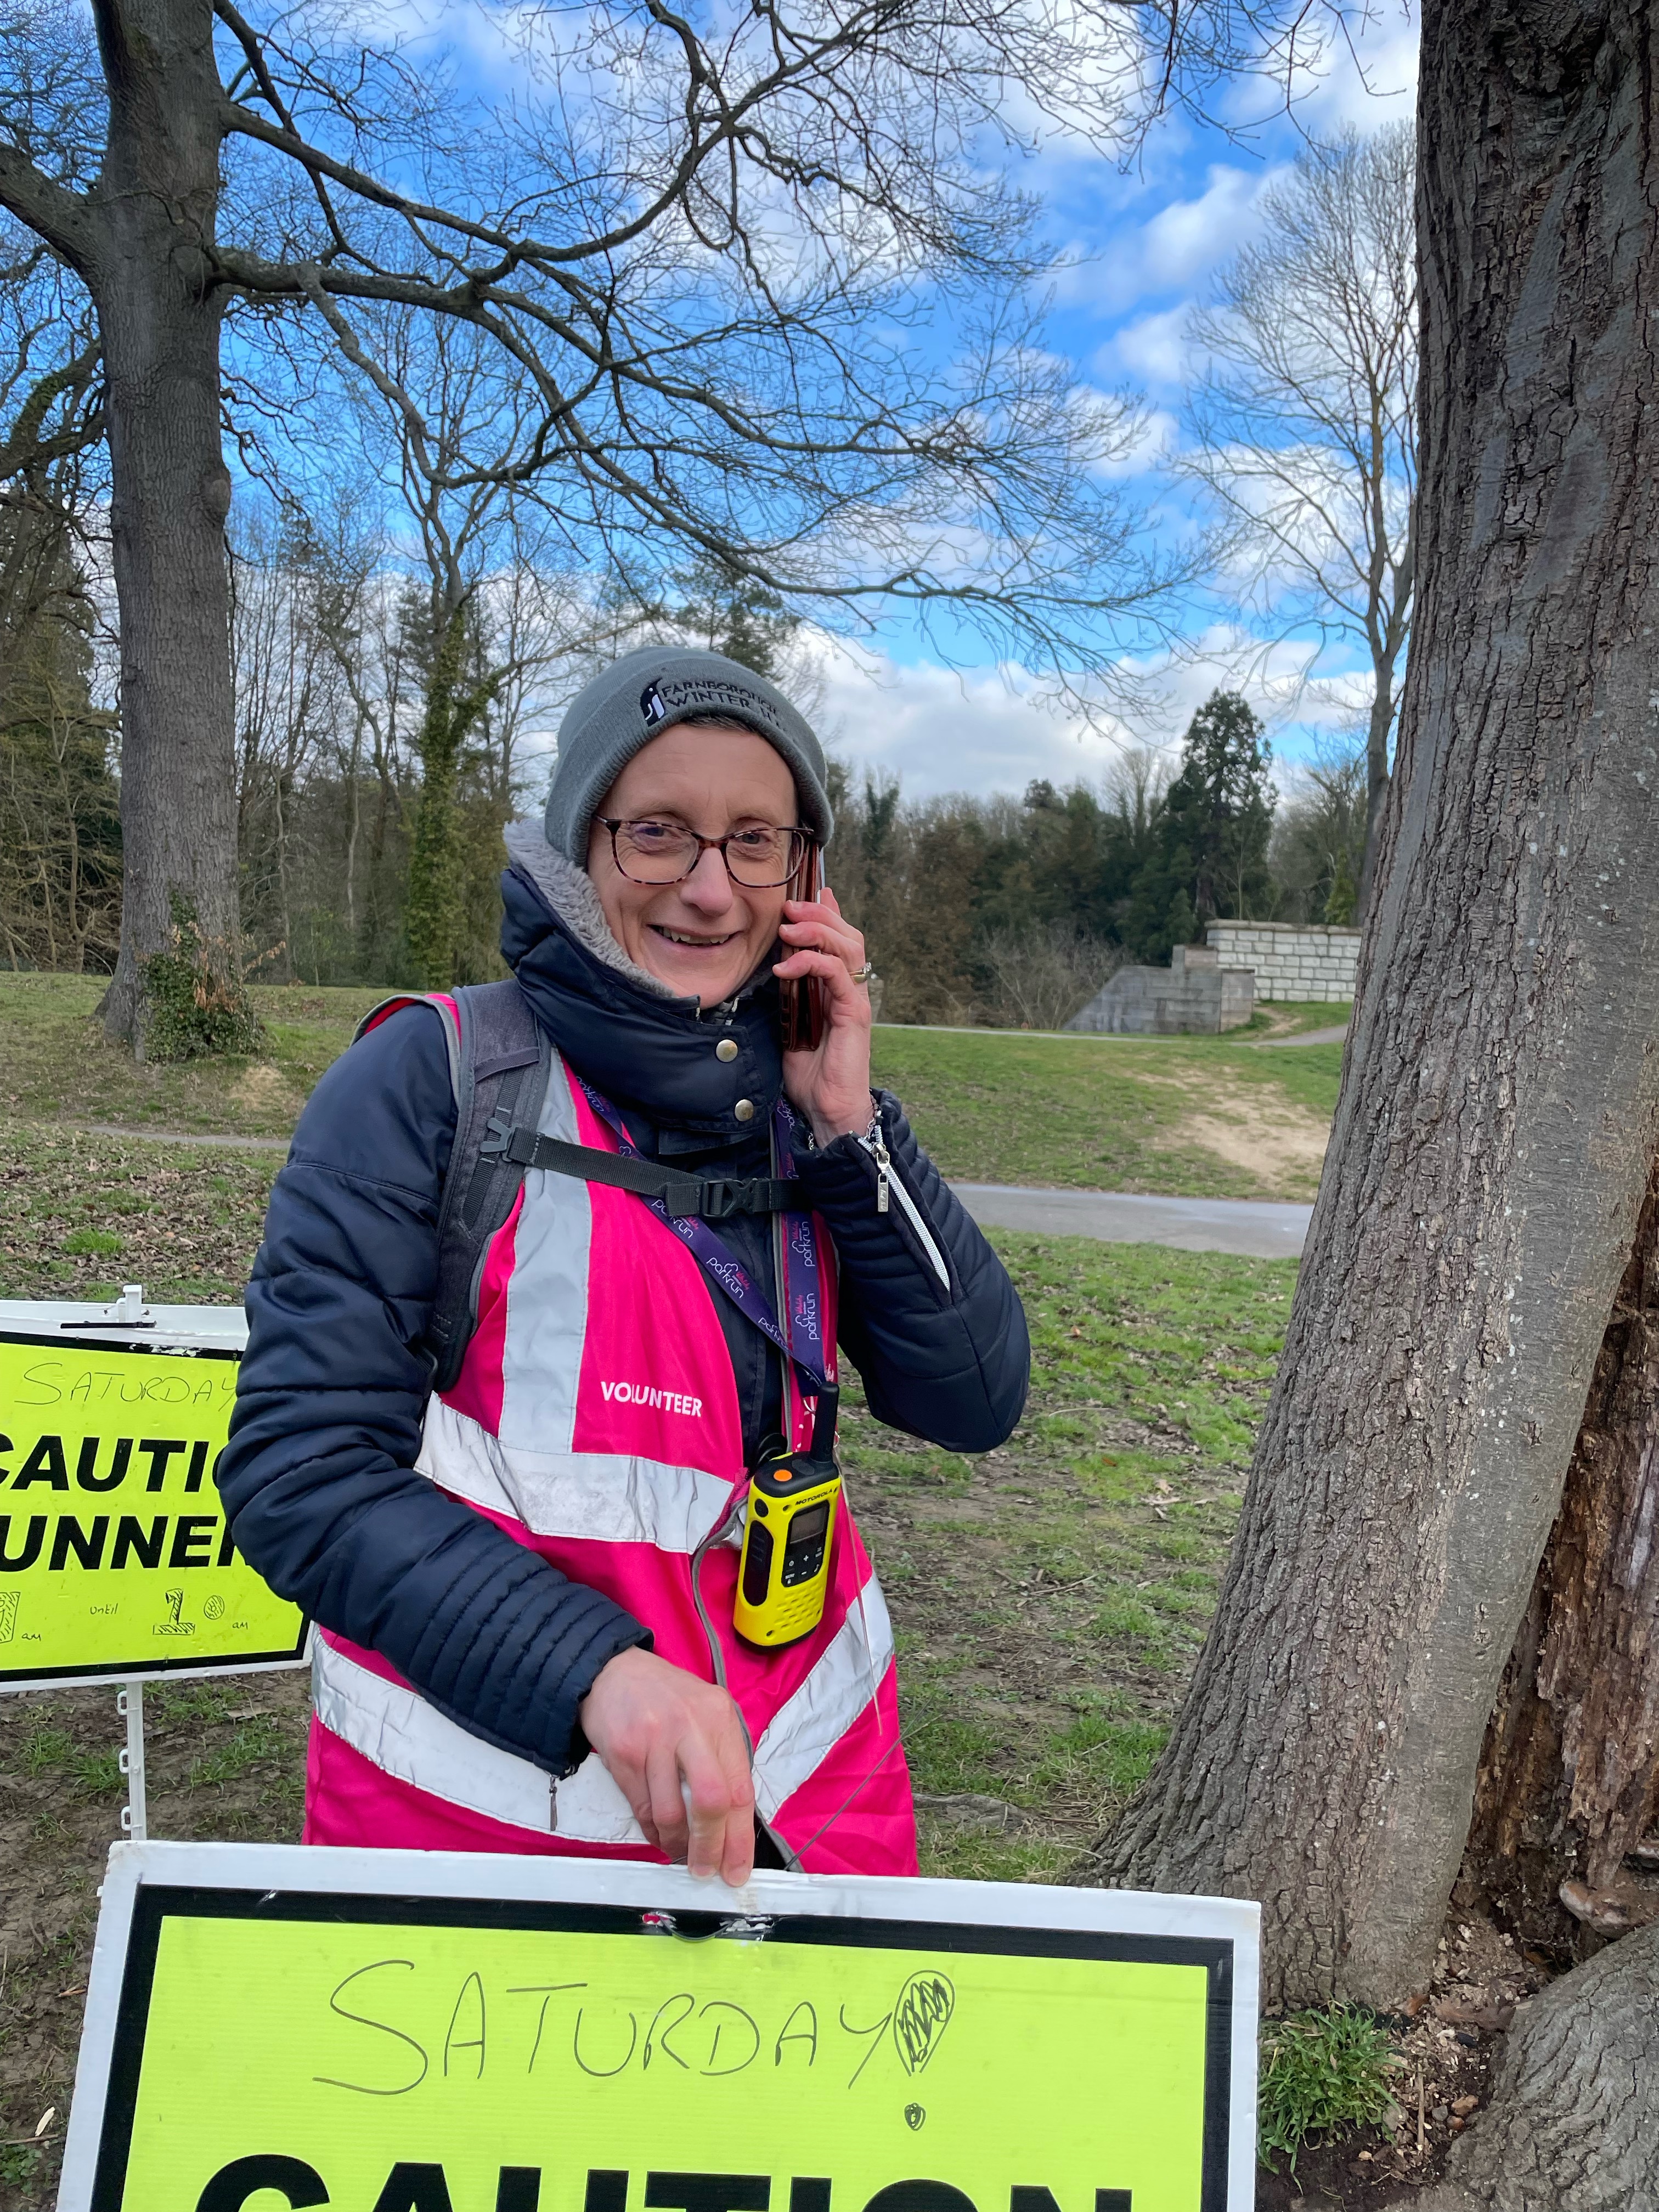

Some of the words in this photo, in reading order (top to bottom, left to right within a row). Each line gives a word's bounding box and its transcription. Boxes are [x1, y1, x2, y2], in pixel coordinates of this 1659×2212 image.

[666, 691, 750, 707] WINTER
[797, 1221, 816, 1267] parkrun
[706, 1257, 744, 1299] parkrun
[800, 1293, 820, 1340] parkrun
[601, 1381, 702, 1417] VOLUNTEER
[0, 1432, 224, 1492] AUTI
